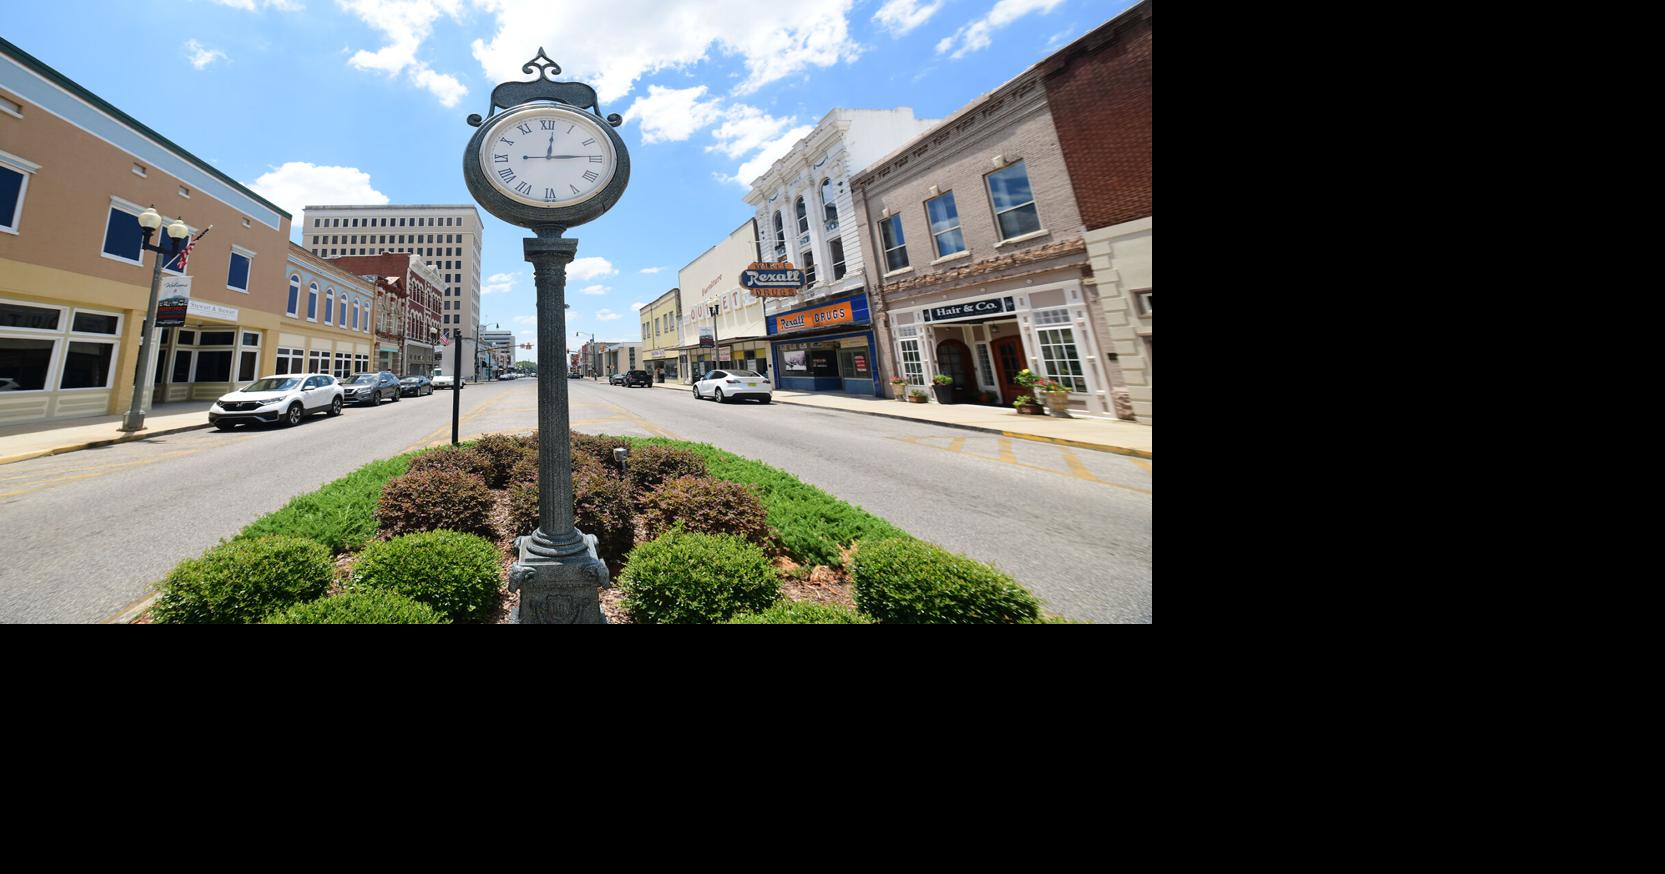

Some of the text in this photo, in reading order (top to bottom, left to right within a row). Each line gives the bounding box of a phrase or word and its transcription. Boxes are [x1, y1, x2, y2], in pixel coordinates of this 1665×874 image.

[516, 123, 532, 135] XI
[540, 120, 555, 130] XII
[566, 125, 574, 134] I
[500, 137, 514, 146] X
[582, 137, 596, 147] II
[494, 154, 508, 163] IX
[498, 167, 517, 184] VIII
[515, 181, 532, 195] VII
[545, 188, 556, 199] VI
[569, 184, 580, 195] V
[745, 270, 801, 286] Rexall
[691, 291, 738, 320] OUTET
[936, 307, 962, 316] Hair
[975, 301, 997, 311] Co.
[780, 308, 845, 330] Rexall DRUGS
